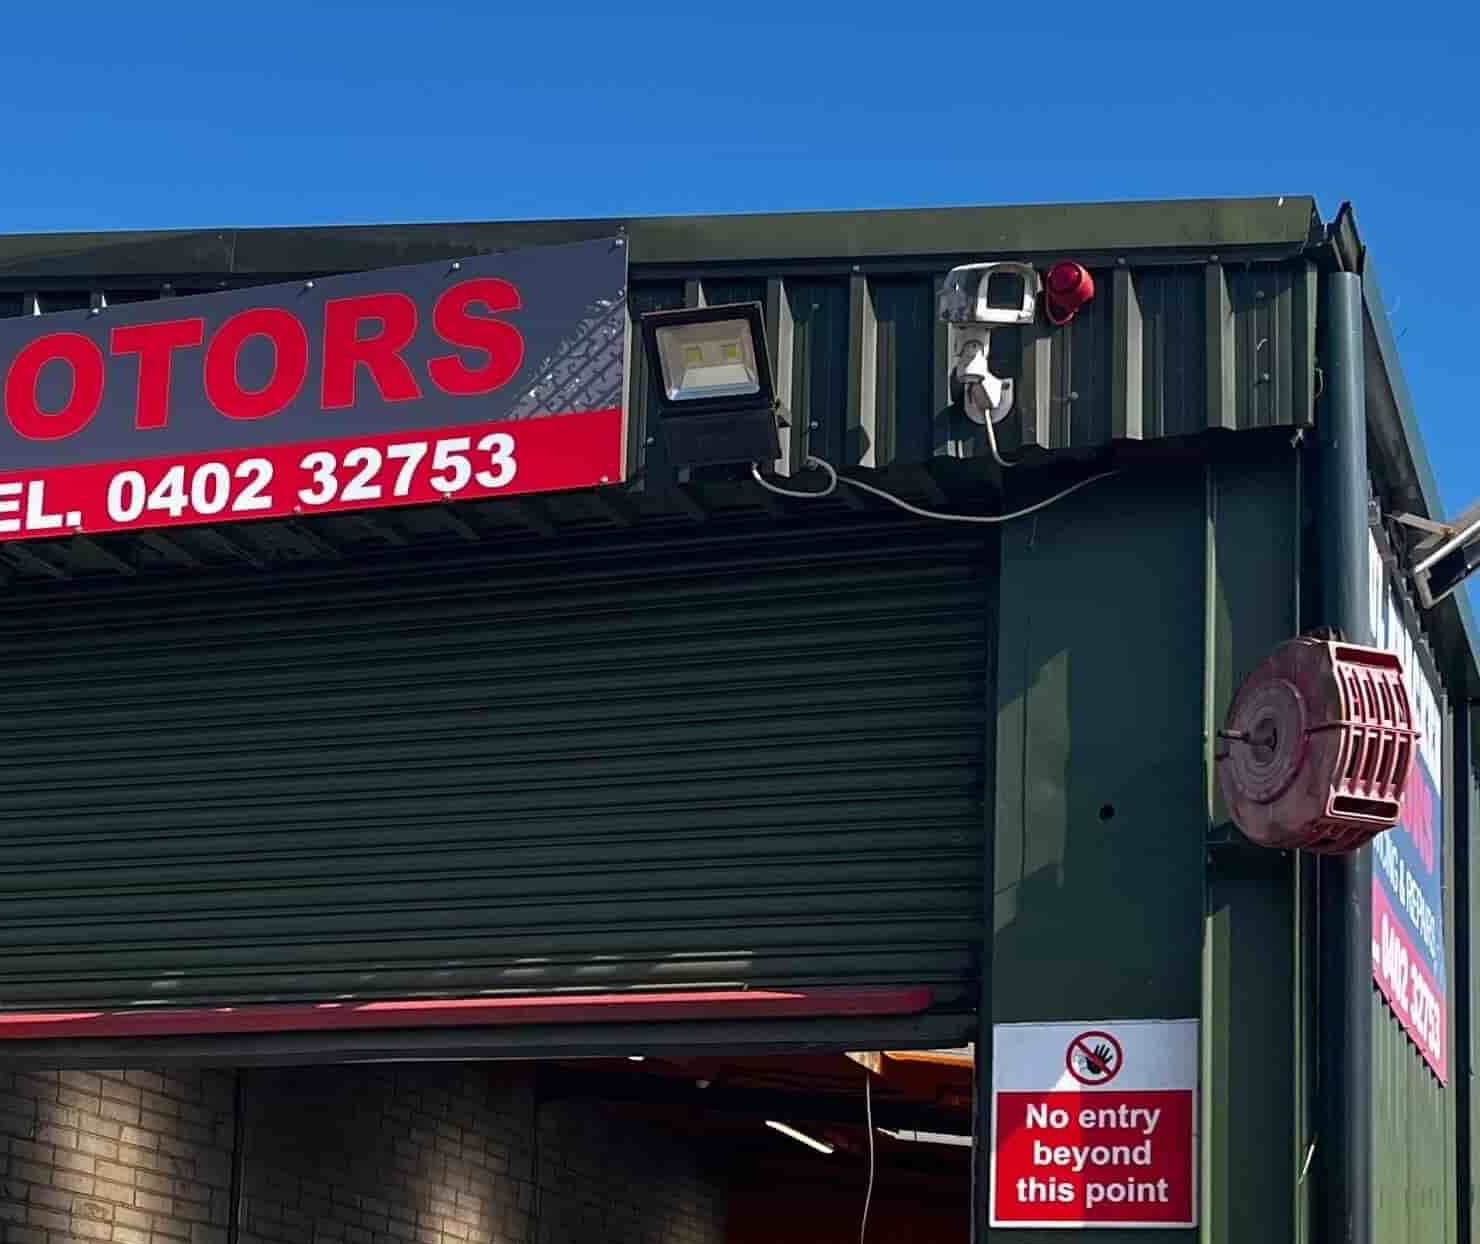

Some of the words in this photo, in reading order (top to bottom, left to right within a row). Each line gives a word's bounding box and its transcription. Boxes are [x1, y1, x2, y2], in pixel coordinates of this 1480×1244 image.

[107, 456, 275, 524] 0402
[299, 432, 518, 508] 32753
[1026, 1103, 1069, 1129] No
[1078, 1105, 1161, 1134] entry
[1033, 1139, 1152, 1172] beyond
[1016, 1177, 1075, 1203] this
[1085, 1177, 1169, 1208] point
